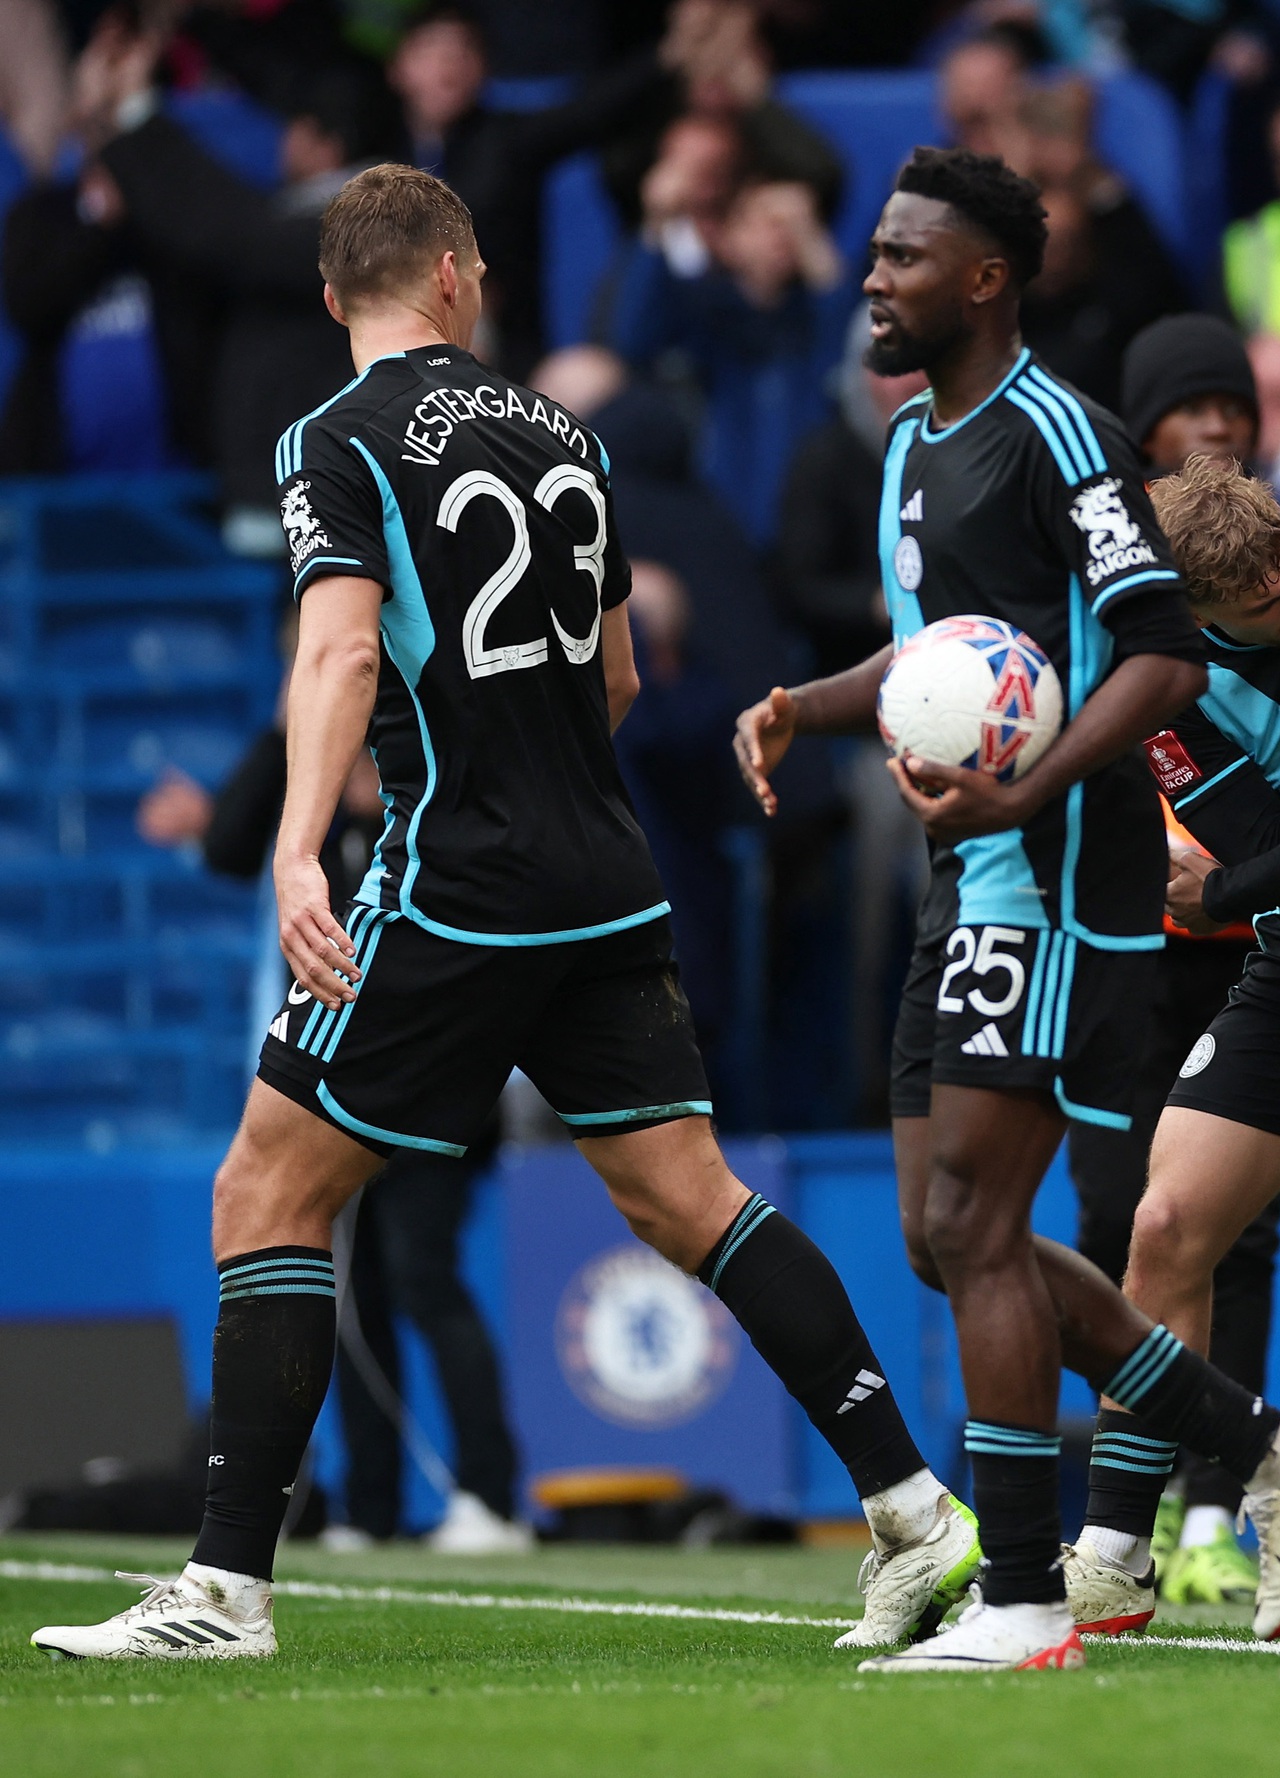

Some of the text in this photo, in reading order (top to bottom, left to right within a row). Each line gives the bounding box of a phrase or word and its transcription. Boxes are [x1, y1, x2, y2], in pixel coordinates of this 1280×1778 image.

[427, 357, 451, 367] LCFC
[401, 385, 588, 466] VESTERGAARD
[436, 463, 607, 680] 23
[1160, 765, 1190, 781] Emirates
[1165, 771, 1194, 789] FA CUP
[937, 925, 1026, 1017] 25
[208, 1454, 225, 1467] FC
[917, 1562, 935, 1575] COPA
[1110, 1575, 1128, 1587] COPA
